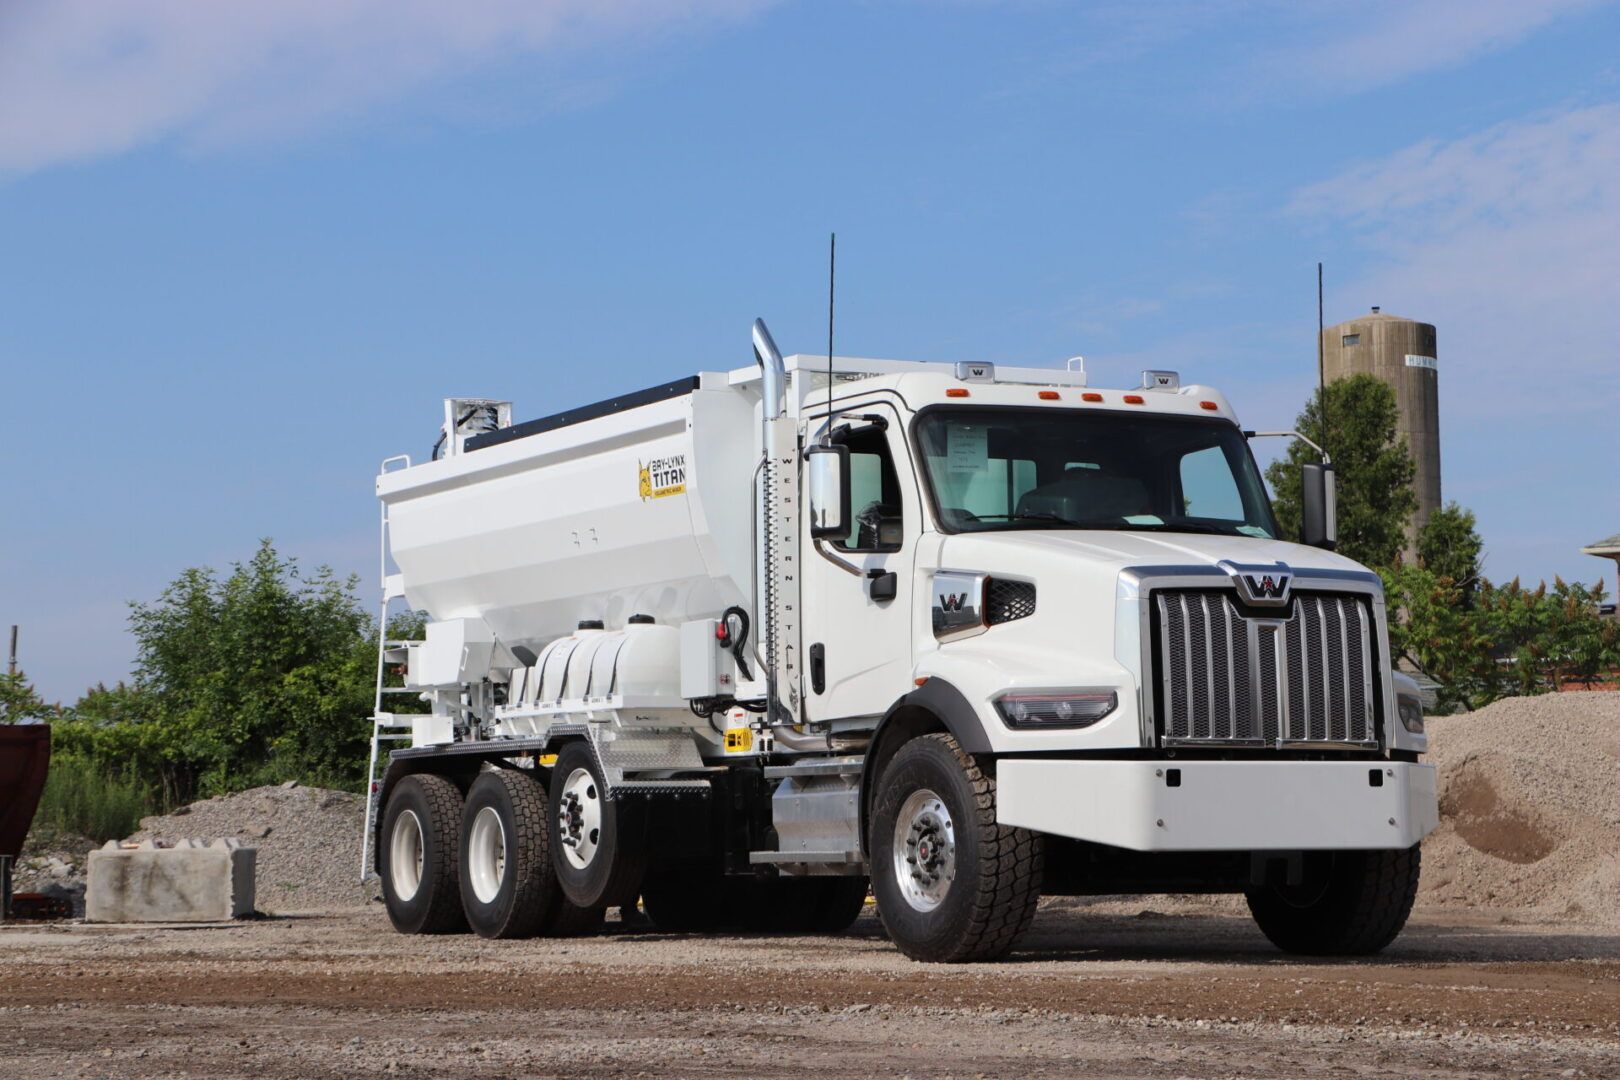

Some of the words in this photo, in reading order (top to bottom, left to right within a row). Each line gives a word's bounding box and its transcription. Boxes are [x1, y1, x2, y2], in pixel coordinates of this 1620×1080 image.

[652, 454, 685, 472] BAY-LYNX
[653, 467, 686, 488] TITAN
[782, 458, 793, 581] WESTERN
[785, 604, 794, 670] STAR
